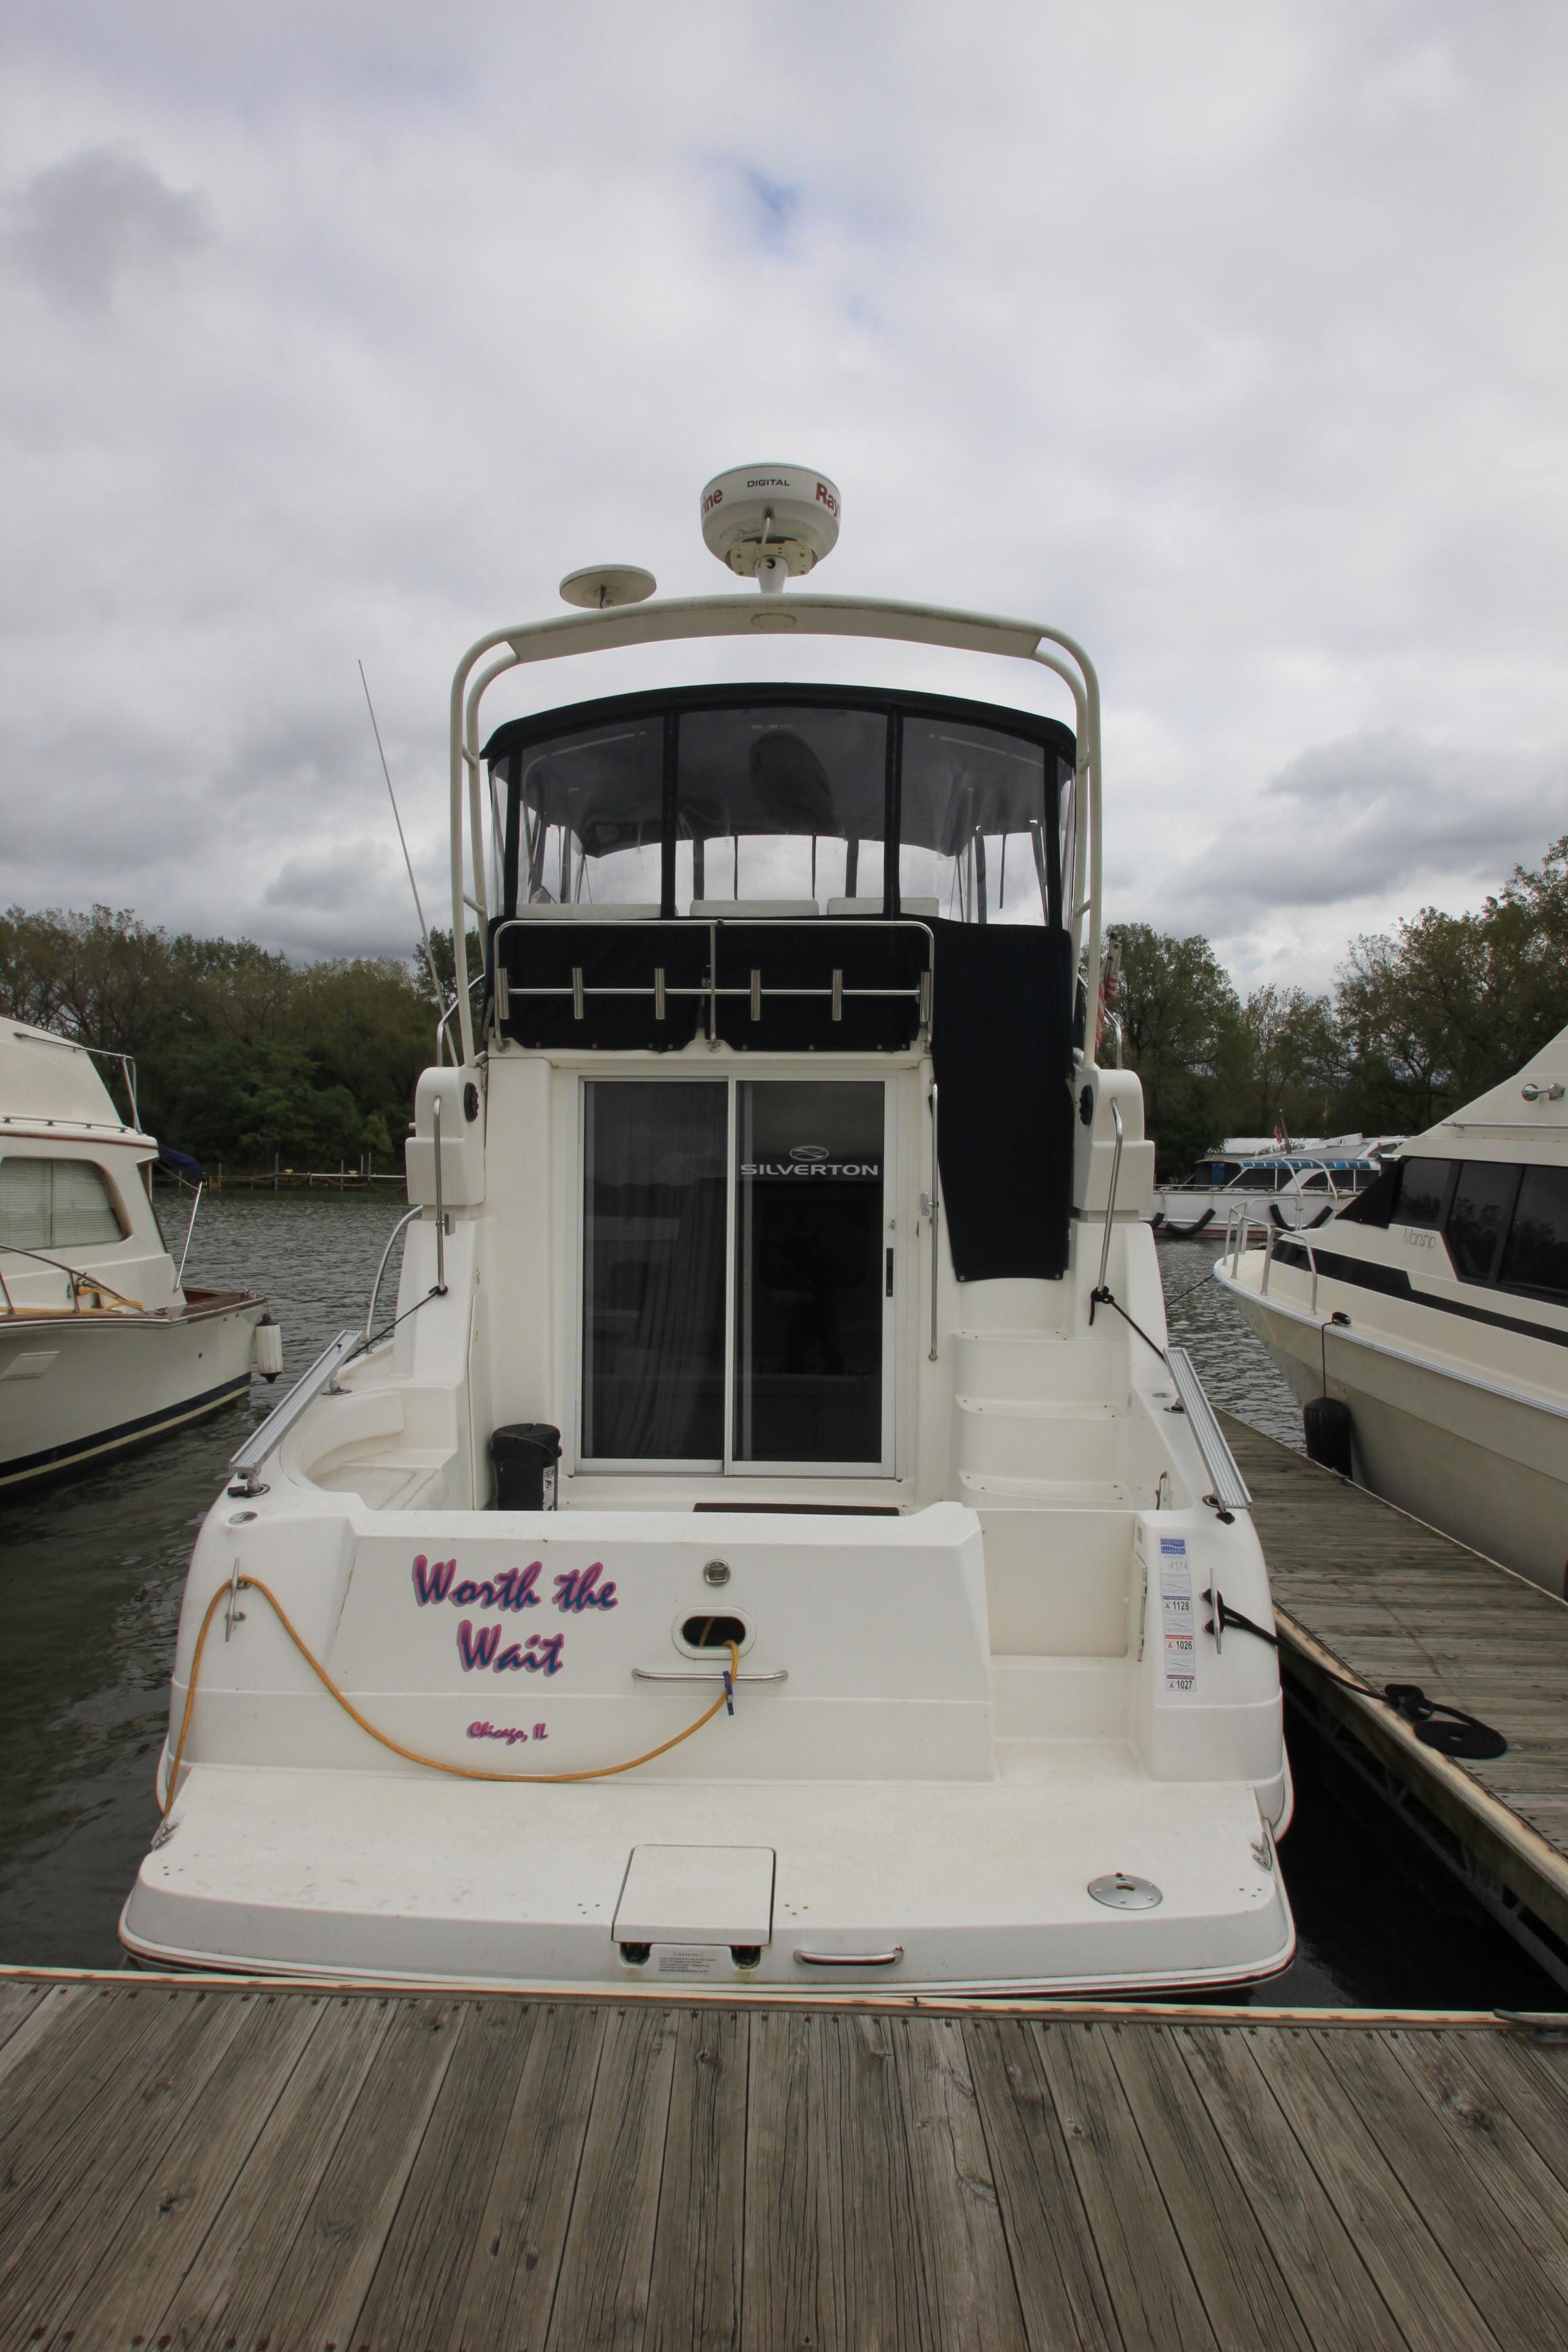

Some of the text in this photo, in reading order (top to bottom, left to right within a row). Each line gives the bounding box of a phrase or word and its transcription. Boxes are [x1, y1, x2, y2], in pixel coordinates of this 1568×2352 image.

[747, 479, 790, 488] DIGITAL
[740, 1164, 878, 1175] SILVERTON
[1402, 1227, 1437, 1253] Mainship
[412, 1554, 618, 1613] Worth the
[1173, 1601, 1190, 1610] 1128
[457, 1619, 564, 1677] Wait
[1176, 1640, 1192, 1650] 1026
[1177, 1680, 1192, 1689] 1027
